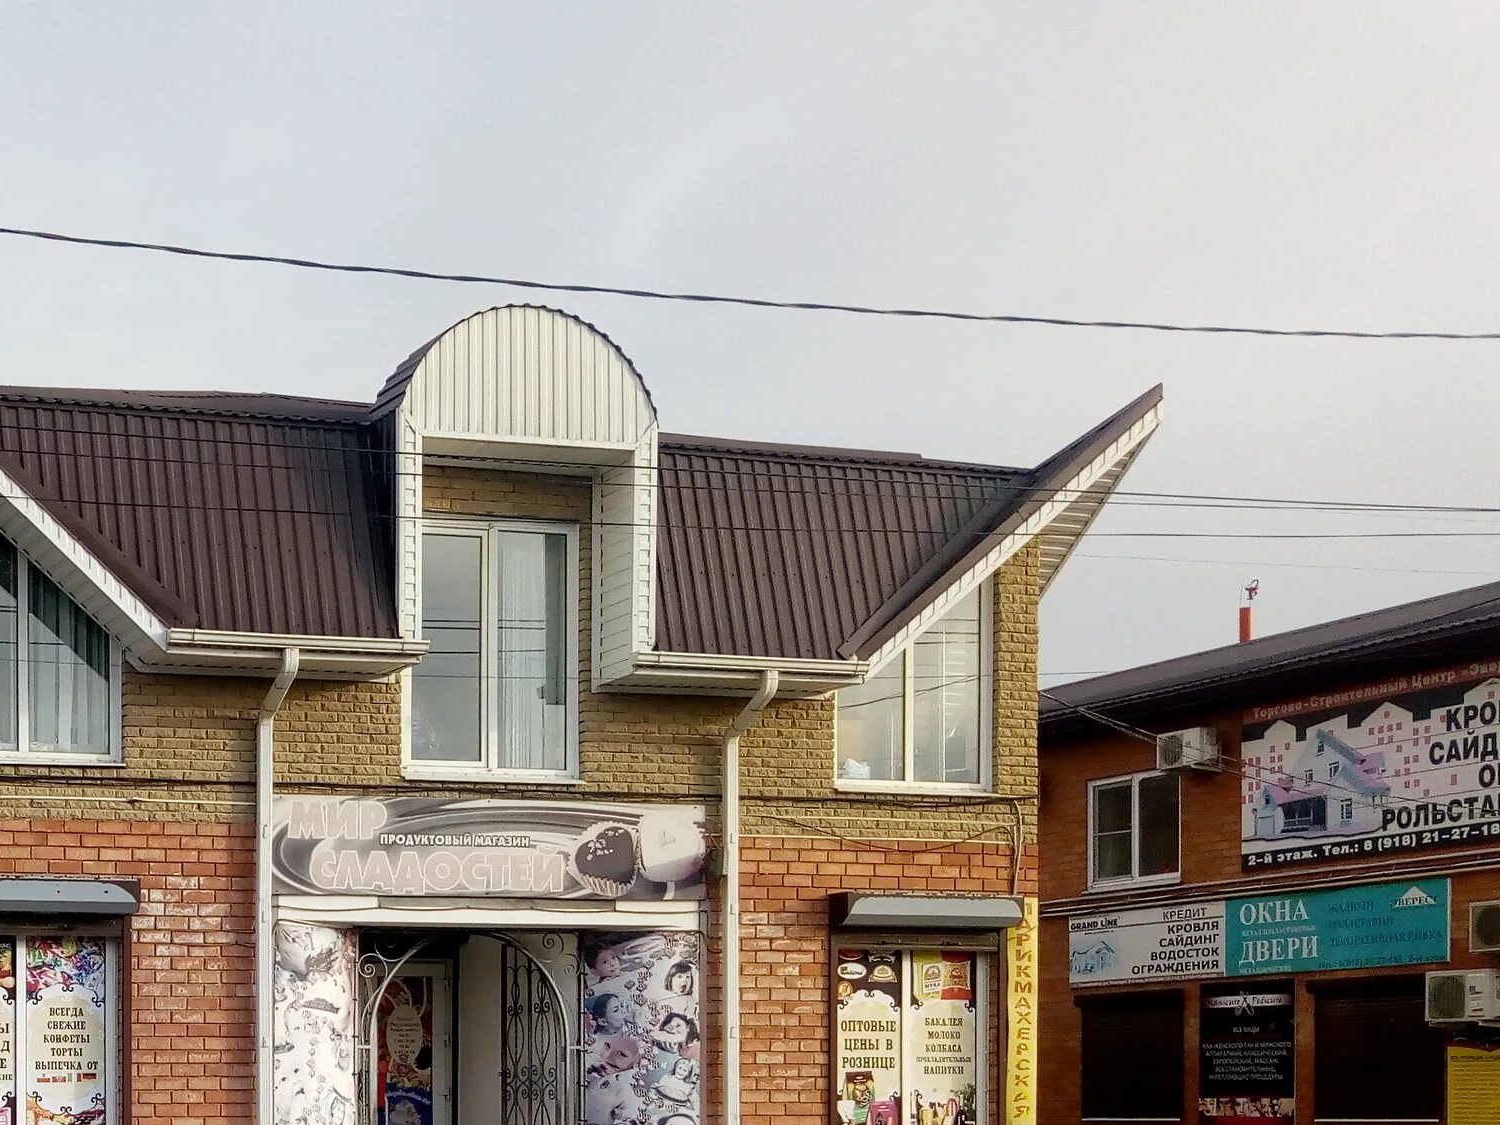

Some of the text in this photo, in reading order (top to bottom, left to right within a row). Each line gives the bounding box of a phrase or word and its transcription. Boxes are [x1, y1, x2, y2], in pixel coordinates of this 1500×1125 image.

[1446, 700, 1500, 732] КРО
[1478, 762, 1500, 788] О
[1382, 793, 1500, 831] РОЛЬСТА
[286, 800, 388, 840] МИР
[379, 832, 531, 848] ПРОДУКТОВЫЙ МАГАЗИН
[1248, 852, 1273, 866] 2-й
[1276, 850, 1317, 862] этаж.
[1323, 843, 1359, 856] Тел.:
[1364, 839, 1373, 851] 8
[1377, 832, 1417, 851] (918)
[308, 845, 565, 895] СЛАДОСТЕЙ
[1163, 907, 1208, 921] КРЕДИТ
[1239, 898, 1309, 926] ОКНА
[1070, 921, 1099, 931] GRAND
[1167, 921, 1220, 935] КРОВЛЯ
[1159, 933, 1220, 948] САЙДИНГ
[1151, 947, 1220, 962] ВОДОСТОК
[1238, 935, 1319, 967] ДВЕРИ
[1131, 959, 1220, 975] ОГРАЖДЕНИЯ
[49, 1007, 84, 1017] ВСЕГДА
[47, 1020, 86, 1030] СВЕЖИЕ
[840, 1020, 897, 1033] ОПТОВЫЕ
[924, 1017, 963, 1026] БАКАЛЕЯ
[43, 1034, 90, 1043] КОНФЕТЫ
[927, 1030, 961, 1039] МОЛОКО
[50, 1047, 83, 1057] ТОРТЫ
[844, 1039, 893, 1052] ЦЕНЫ В
[925, 1044, 963, 1053] КОЛБАСА
[35, 1061, 99, 1071] ВЫПЕЧКА ОТ
[841, 1056, 896, 1070] РОЗНИЦЕ
[923, 1065, 964, 1075] НАПИТКИ
